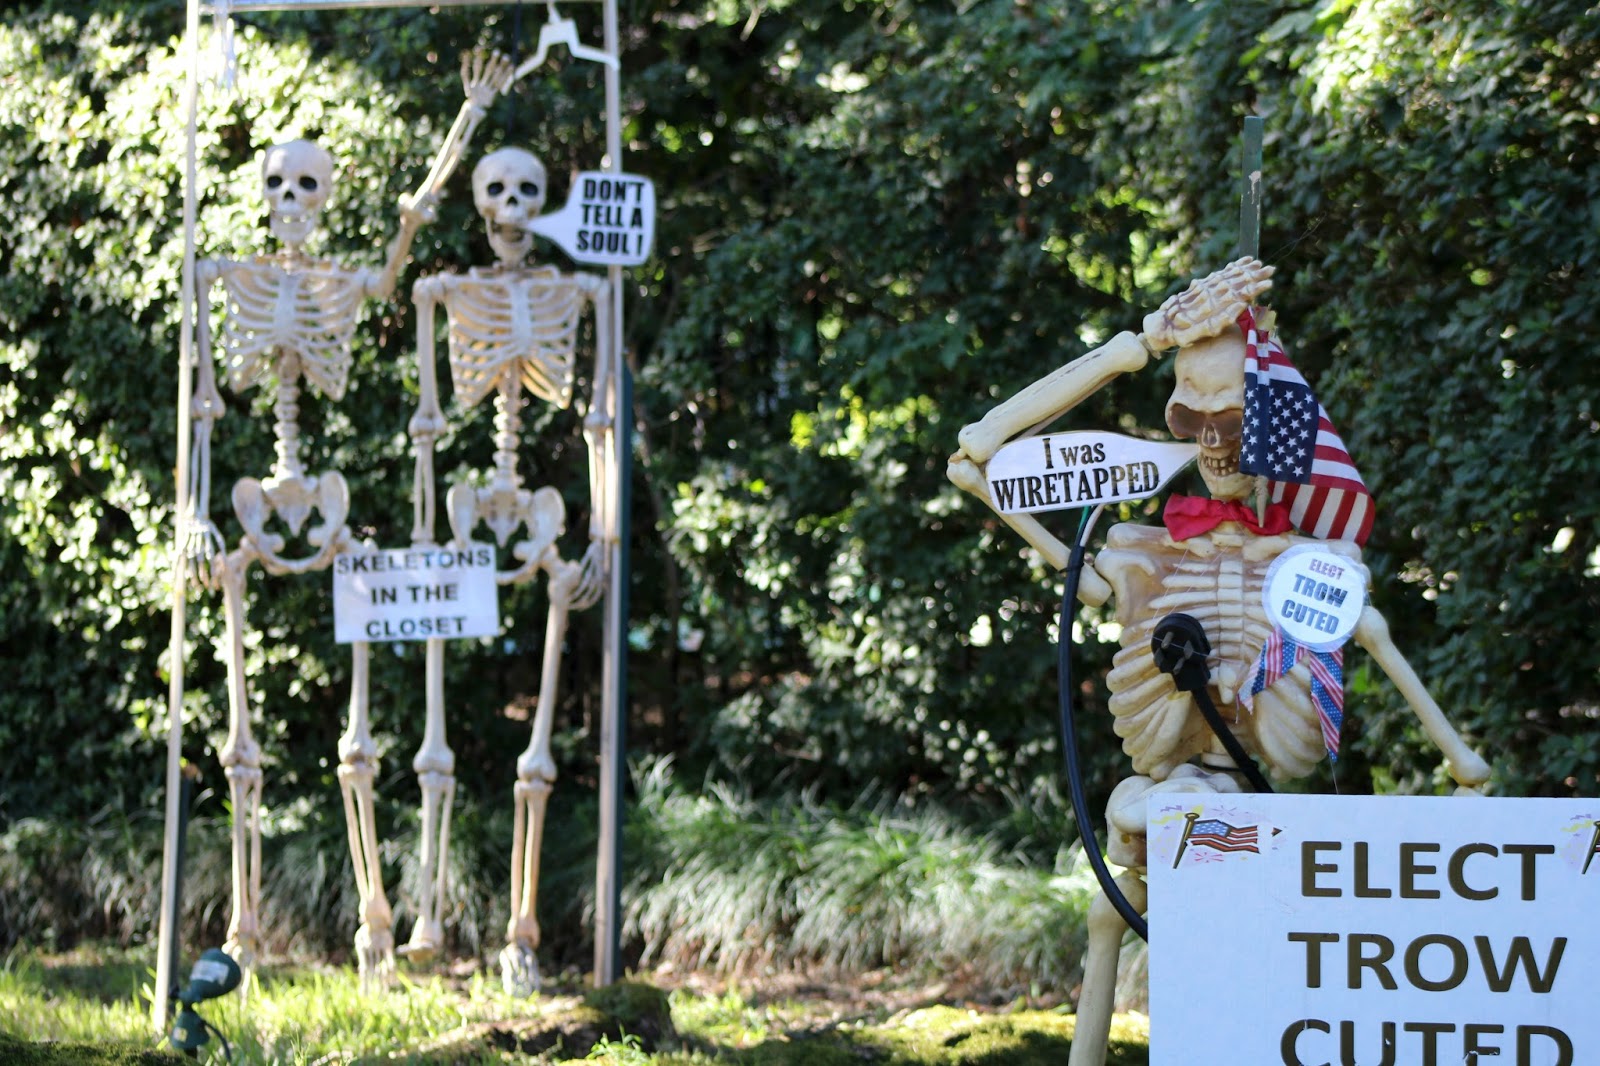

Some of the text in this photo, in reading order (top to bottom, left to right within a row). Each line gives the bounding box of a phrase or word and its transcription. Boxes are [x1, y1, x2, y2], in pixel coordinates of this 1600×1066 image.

[583, 179, 645, 203] DON'T
[581, 203, 643, 228] TELL A
[1042, 437, 1106, 470] I was
[991, 460, 1160, 511] WIRETAPPED
[336, 549, 492, 575] SKELETONS
[1308, 558, 1346, 580] ELECT
[371, 583, 459, 605] IN THE
[1292, 573, 1349, 609] TROW
[365, 616, 468, 639] CLOSET
[1280, 599, 1340, 635] CUTED
[1300, 841, 1556, 901] ELECT
[1287, 931, 1568, 994] TROW
[1279, 1018, 1574, 1066] CUTED
